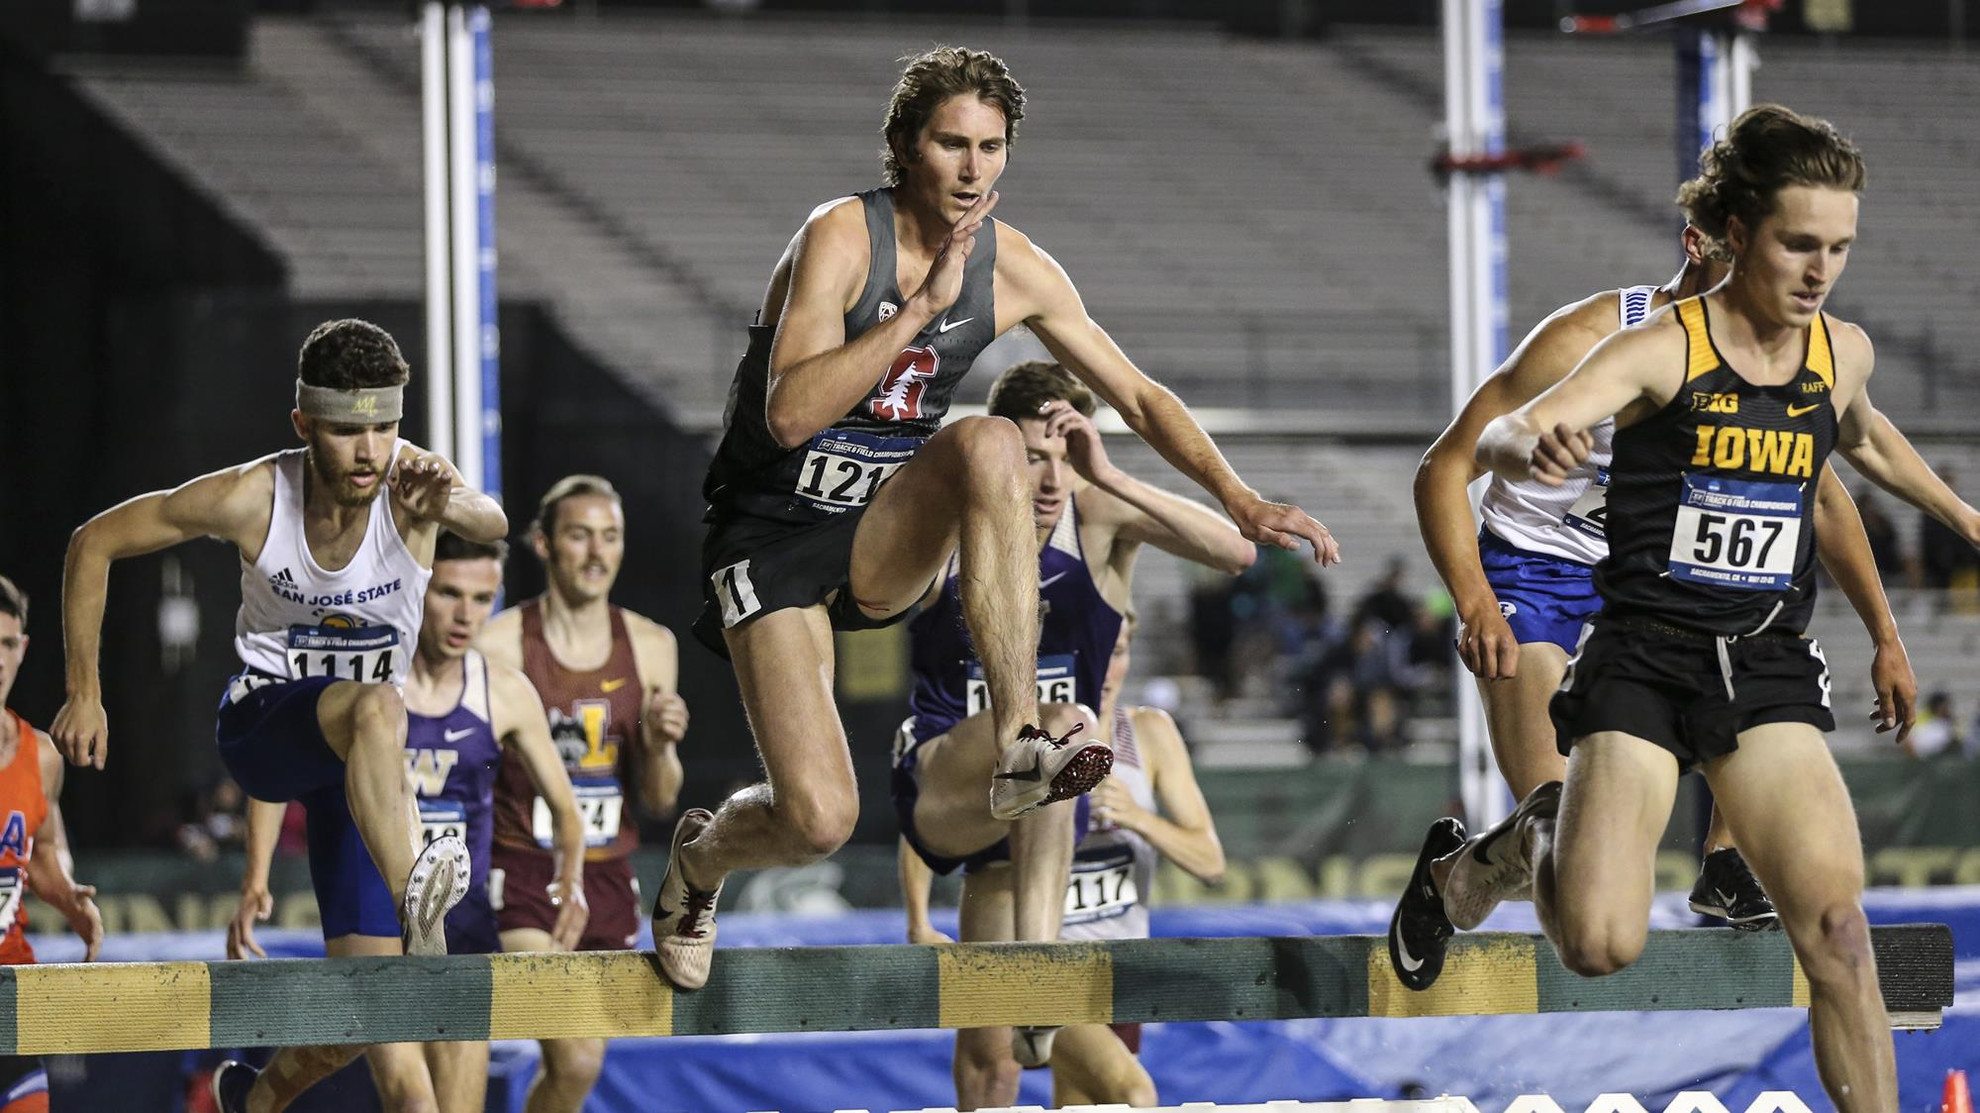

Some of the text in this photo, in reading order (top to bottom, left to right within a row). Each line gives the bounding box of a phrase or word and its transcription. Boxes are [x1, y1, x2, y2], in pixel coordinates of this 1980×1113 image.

[1802, 381, 1826, 394] RAFF
[832, 442, 852, 452] TRACK
[856, 447, 874, 457] FIELD
[1691, 425, 1814, 479] IOWA
[1705, 494, 1728, 505] TRACK
[1732, 498, 1750, 508] FIELD
[1750, 500, 1797, 512] CHAMPIONSHIPS
[1694, 513, 1783, 569] 567
[308, 589, 353, 606] JOSÉ
[357, 578, 402, 603] STATE
[293, 649, 394, 684] 1114
[572, 699, 622, 773] L
[400, 748, 459, 797] W
[0, 811, 26, 860] A
[1072, 867, 1129, 911] 117
